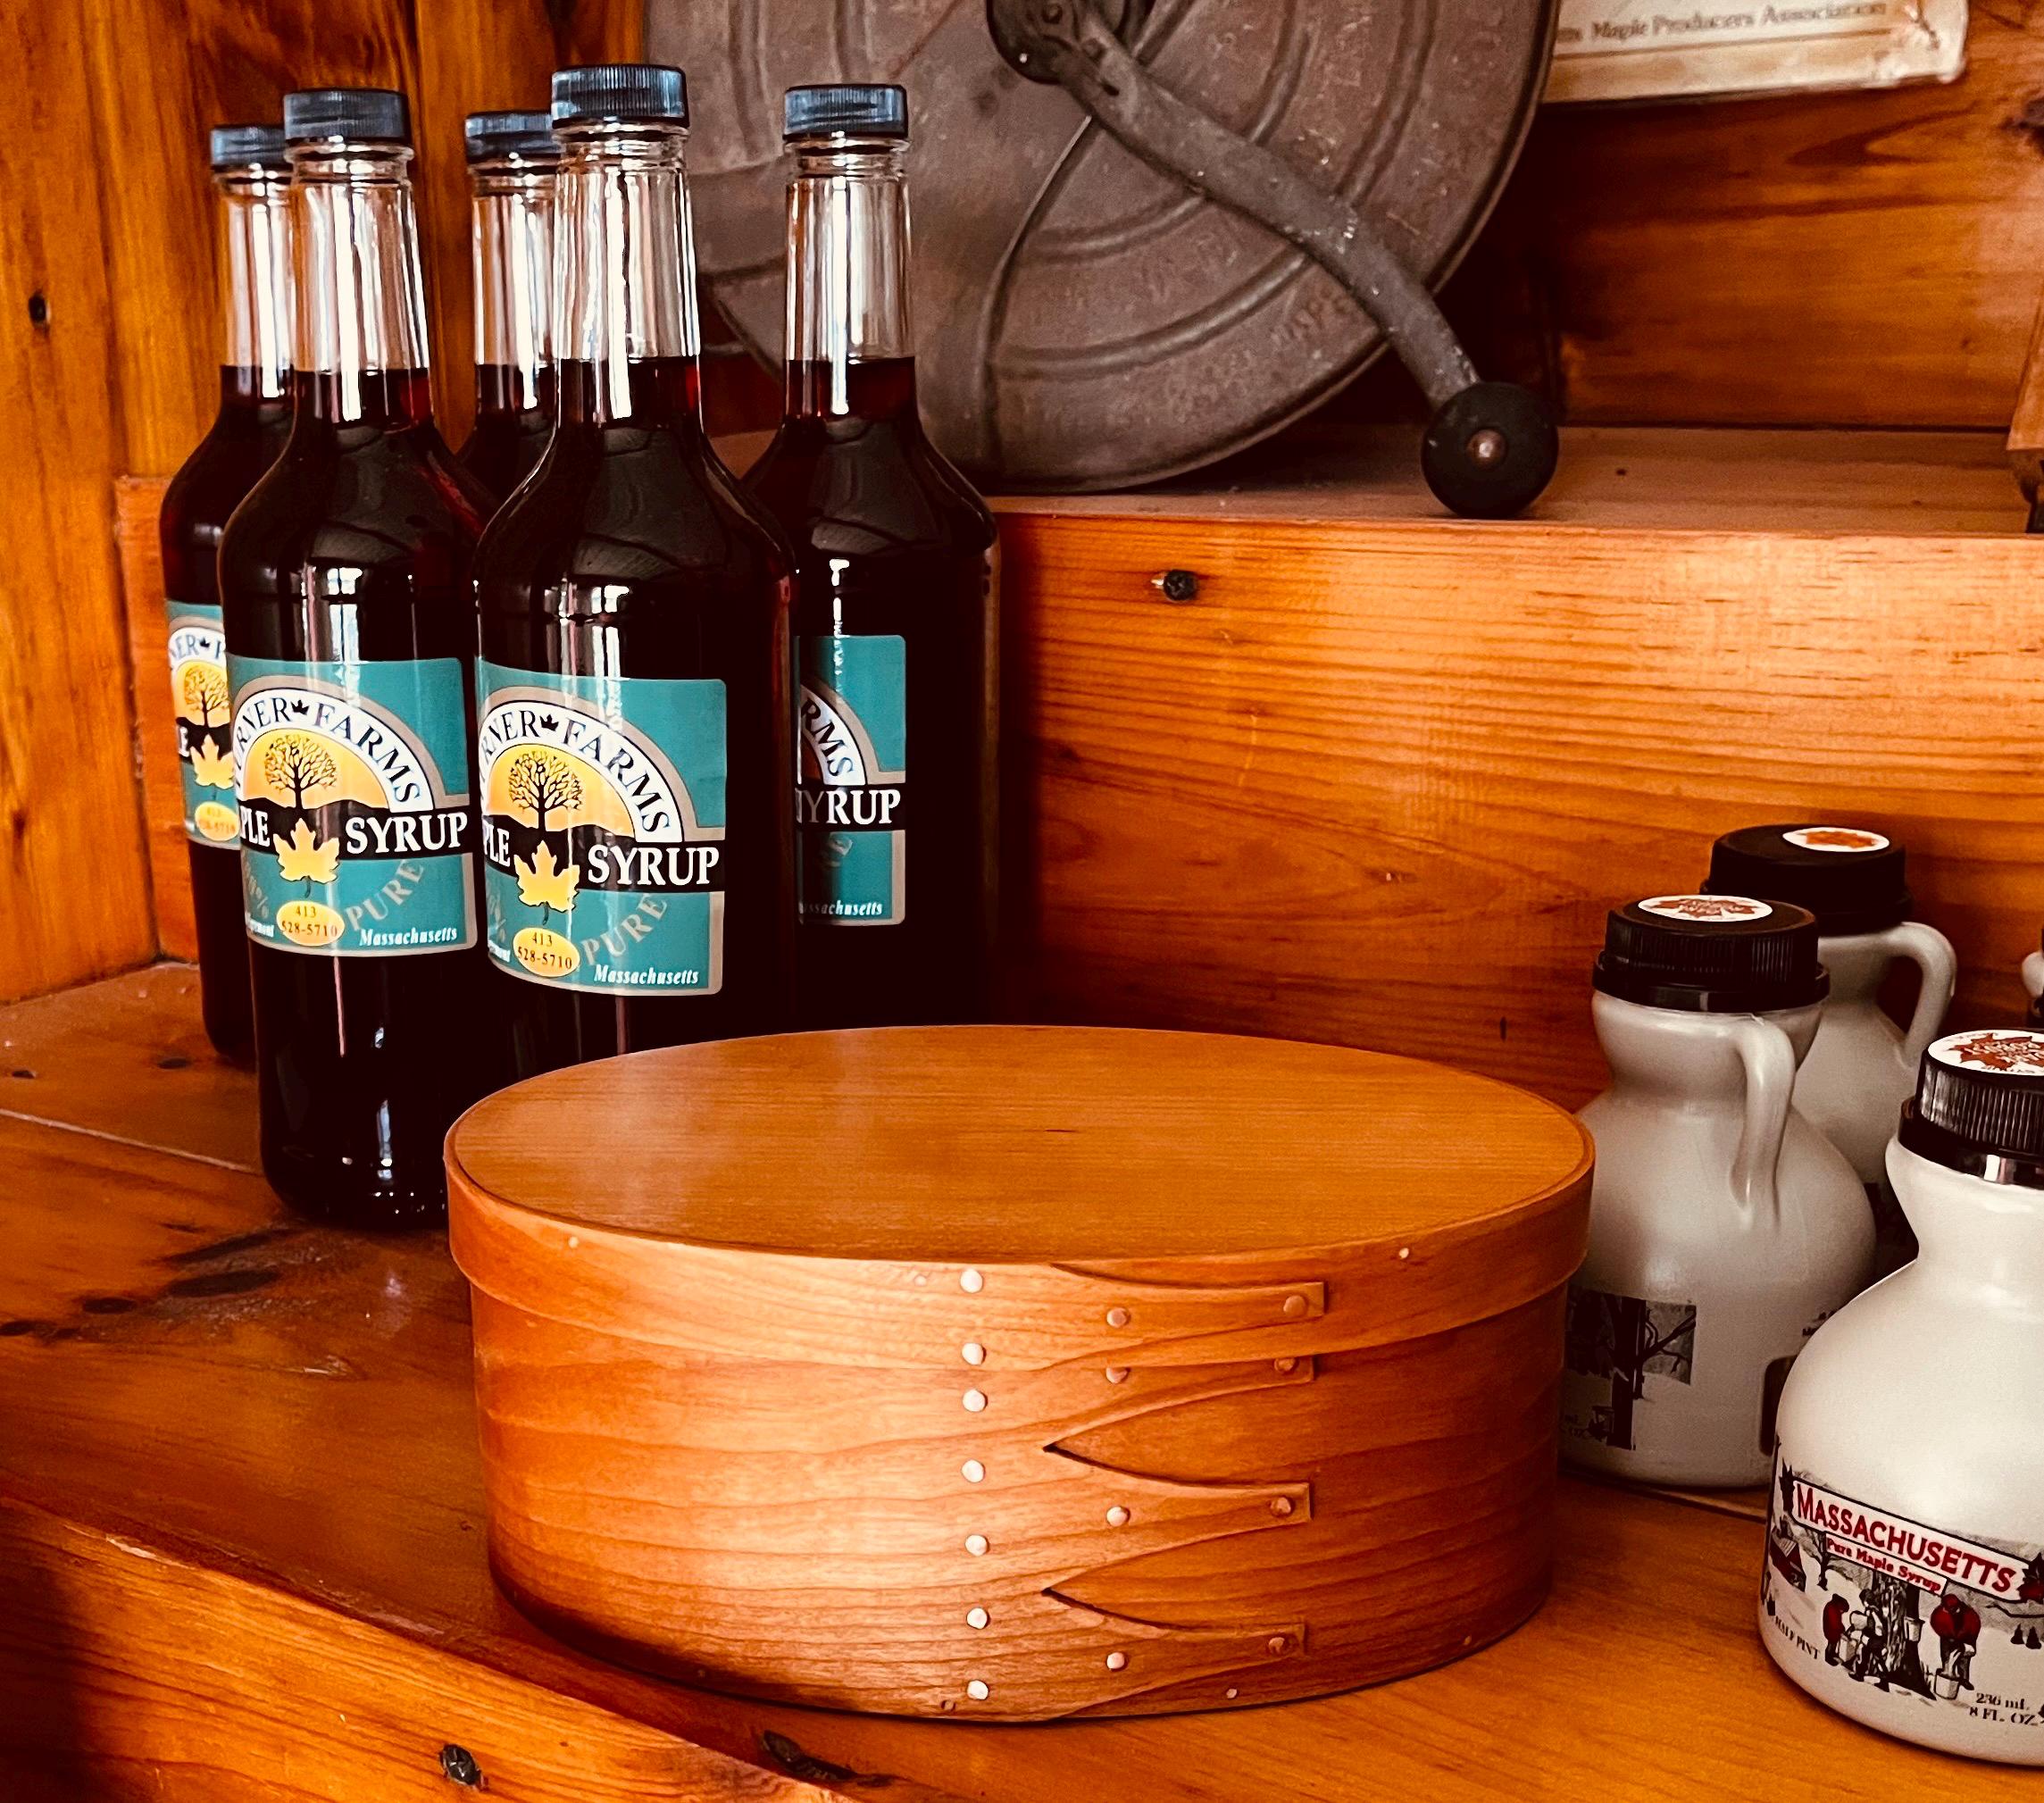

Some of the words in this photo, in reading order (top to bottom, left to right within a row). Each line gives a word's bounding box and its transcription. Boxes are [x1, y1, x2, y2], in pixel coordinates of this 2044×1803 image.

[1591, 19, 1648, 41] Maple
[1653, 13, 1755, 36] Producers
[1760, 3, 1887, 26] Association
[313, 702, 421, 803] FARMS
[563, 717, 671, 834] FARMS
[346, 811, 468, 854] SYRUP
[587, 844, 721, 888] SYRUP
[296, 906, 316, 919] 413
[345, 858, 425, 931] PURE
[281, 921, 338, 938] 528-5710
[359, 927, 457, 947] Massachusetts
[531, 931, 554, 948] 413
[580, 894, 668, 967] PURE
[516, 946, 573, 971] 528-5710
[594, 964, 699, 985] Massachusetts
[1797, 1483, 2017, 1593] MASSACHUSETTS
[1826, 1536, 1853, 1557] Pure
[1856, 1548, 1895, 1575] Maple
[1898, 1565, 1942, 1595] Syrup
[1797, 1636, 1822, 1659] PINT
